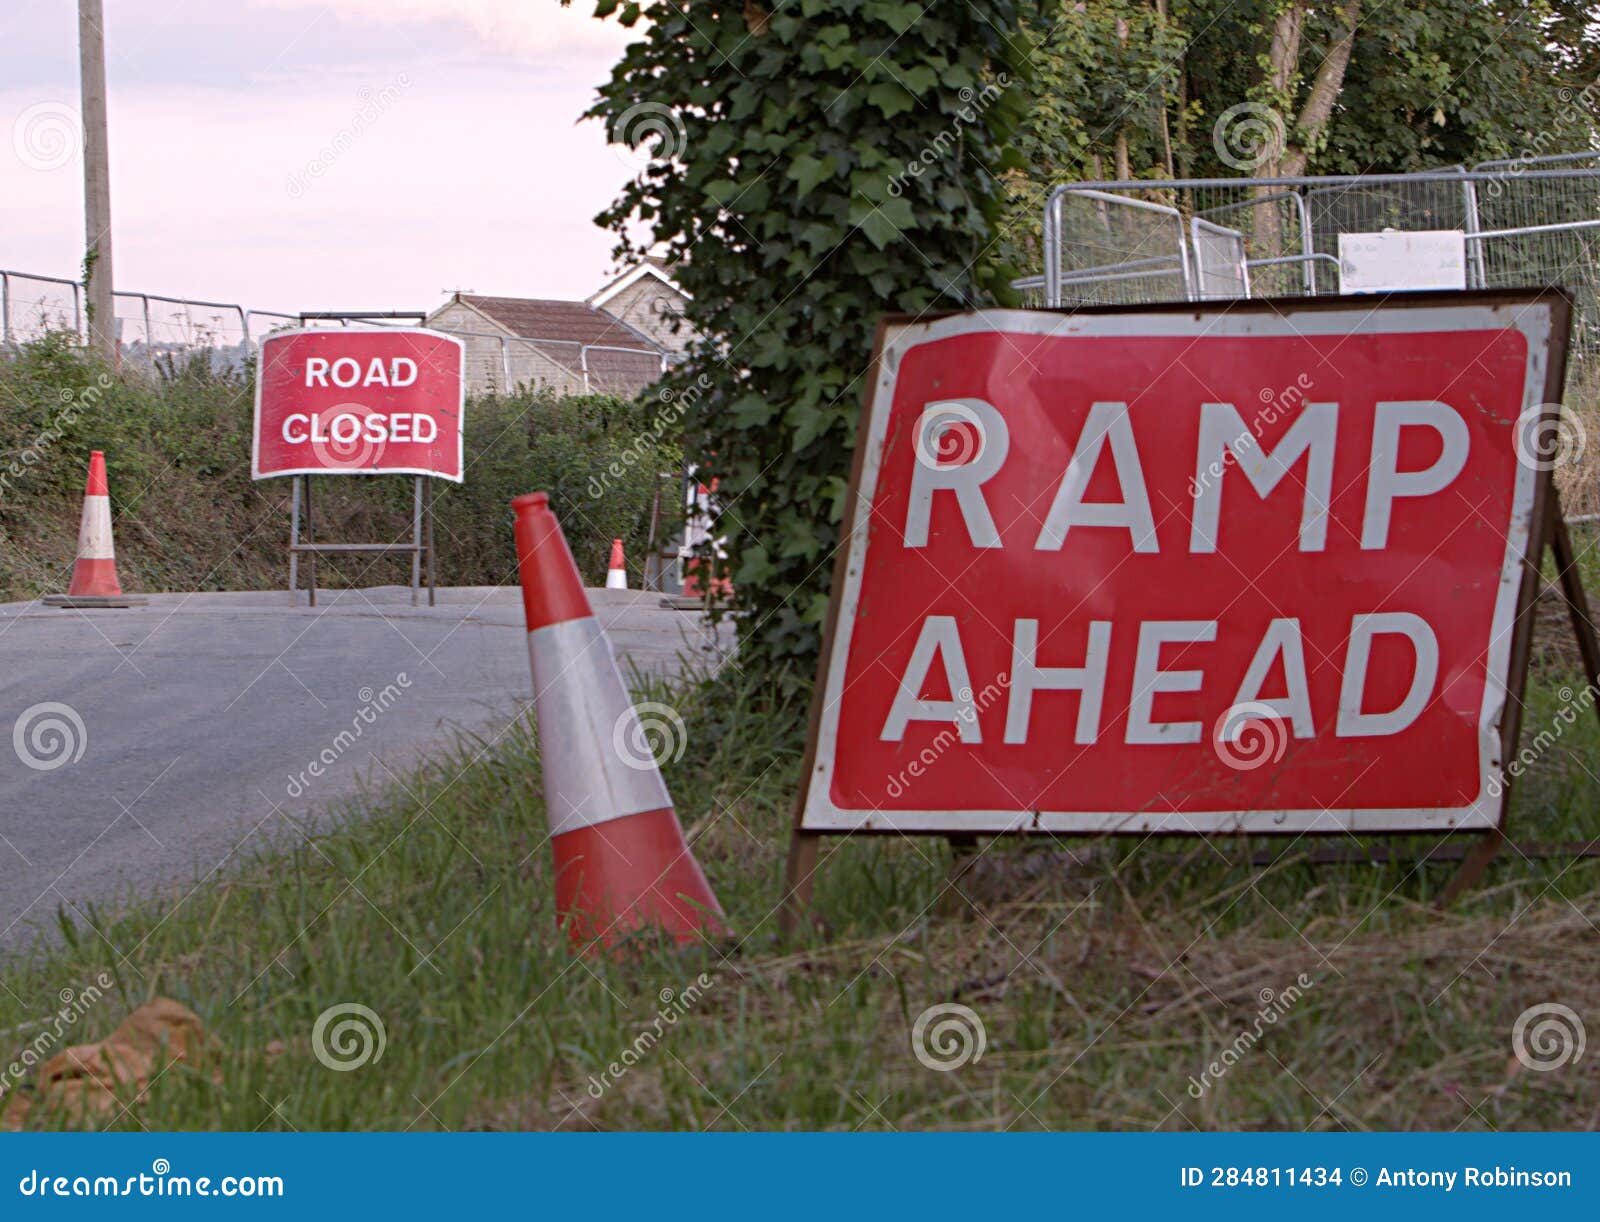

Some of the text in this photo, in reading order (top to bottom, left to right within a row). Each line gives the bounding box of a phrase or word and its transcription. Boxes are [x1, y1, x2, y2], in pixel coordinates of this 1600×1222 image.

[305, 357, 418, 388] ROAD
[282, 412, 438, 444] CLOSED
[903, 398, 1471, 554] RAMP
[879, 611, 1440, 745] AHEAD
